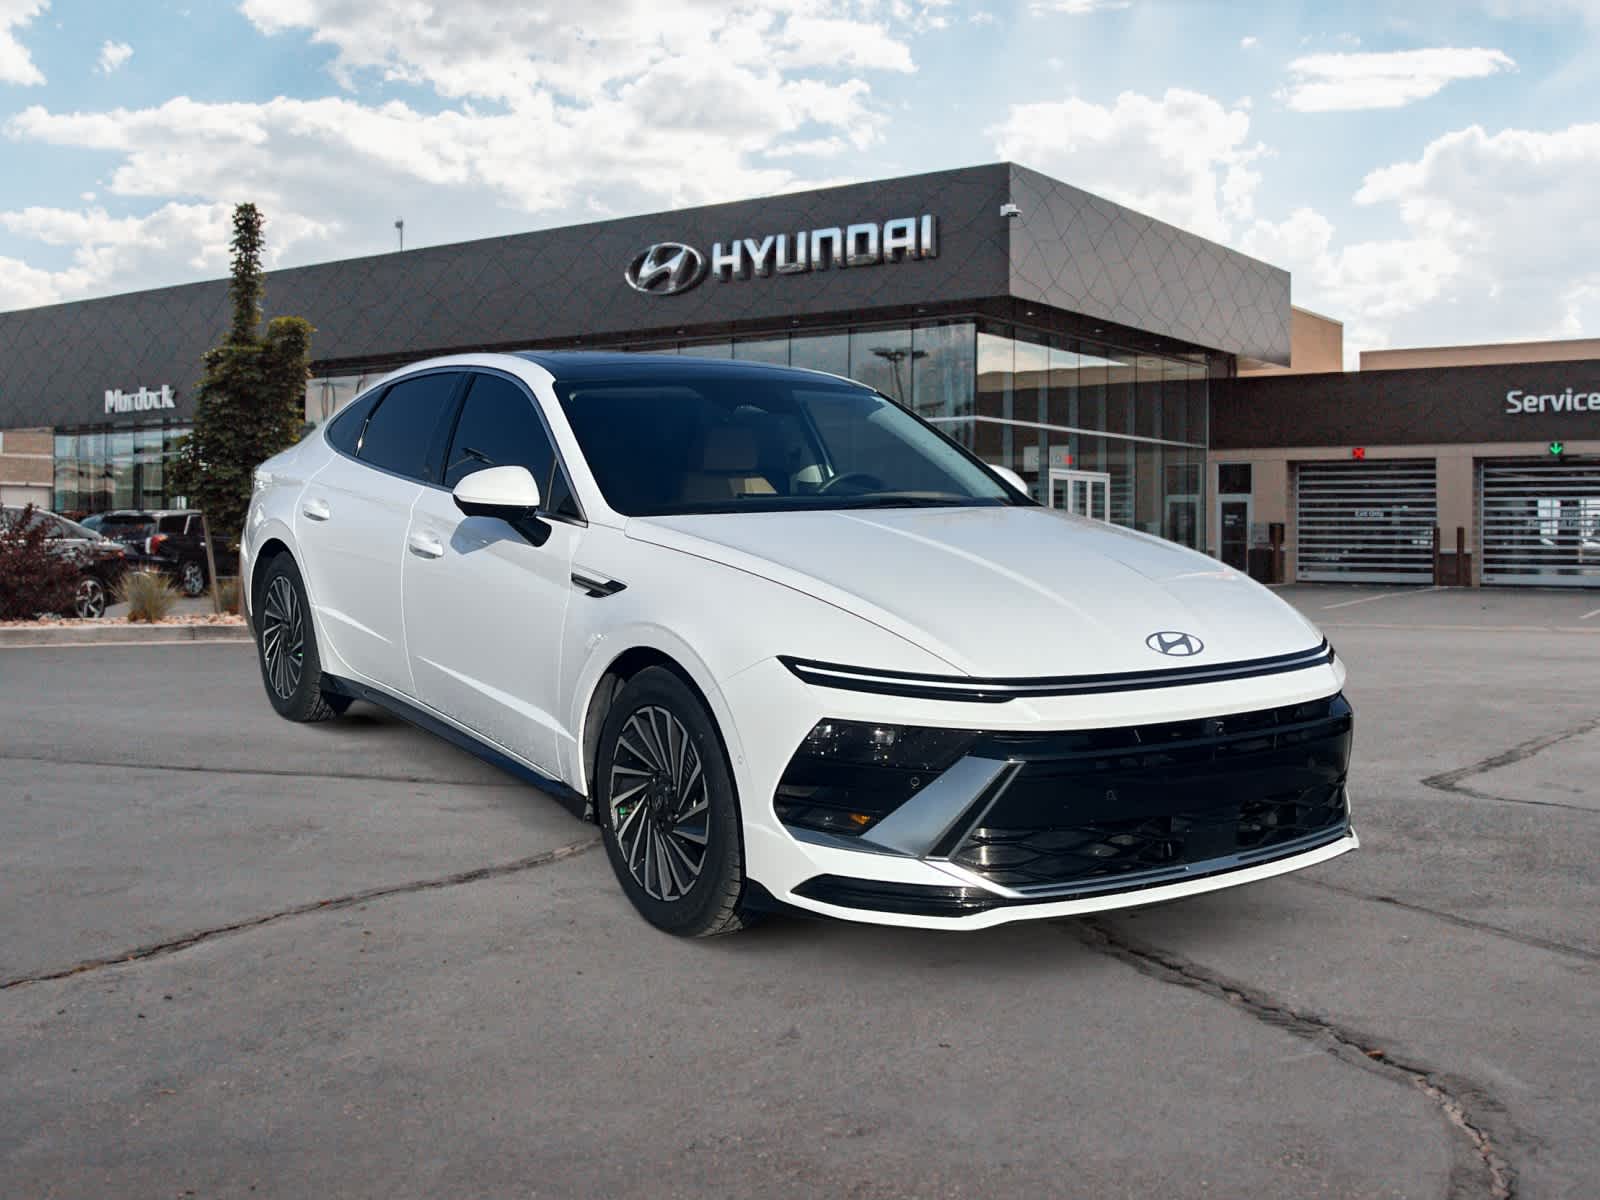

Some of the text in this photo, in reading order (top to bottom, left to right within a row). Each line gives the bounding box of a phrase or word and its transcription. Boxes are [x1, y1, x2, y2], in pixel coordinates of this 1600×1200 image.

[712, 214, 935, 282] HYUNDAI
[104, 384, 176, 414] Murdock
[1505, 388, 1600, 413] Service
